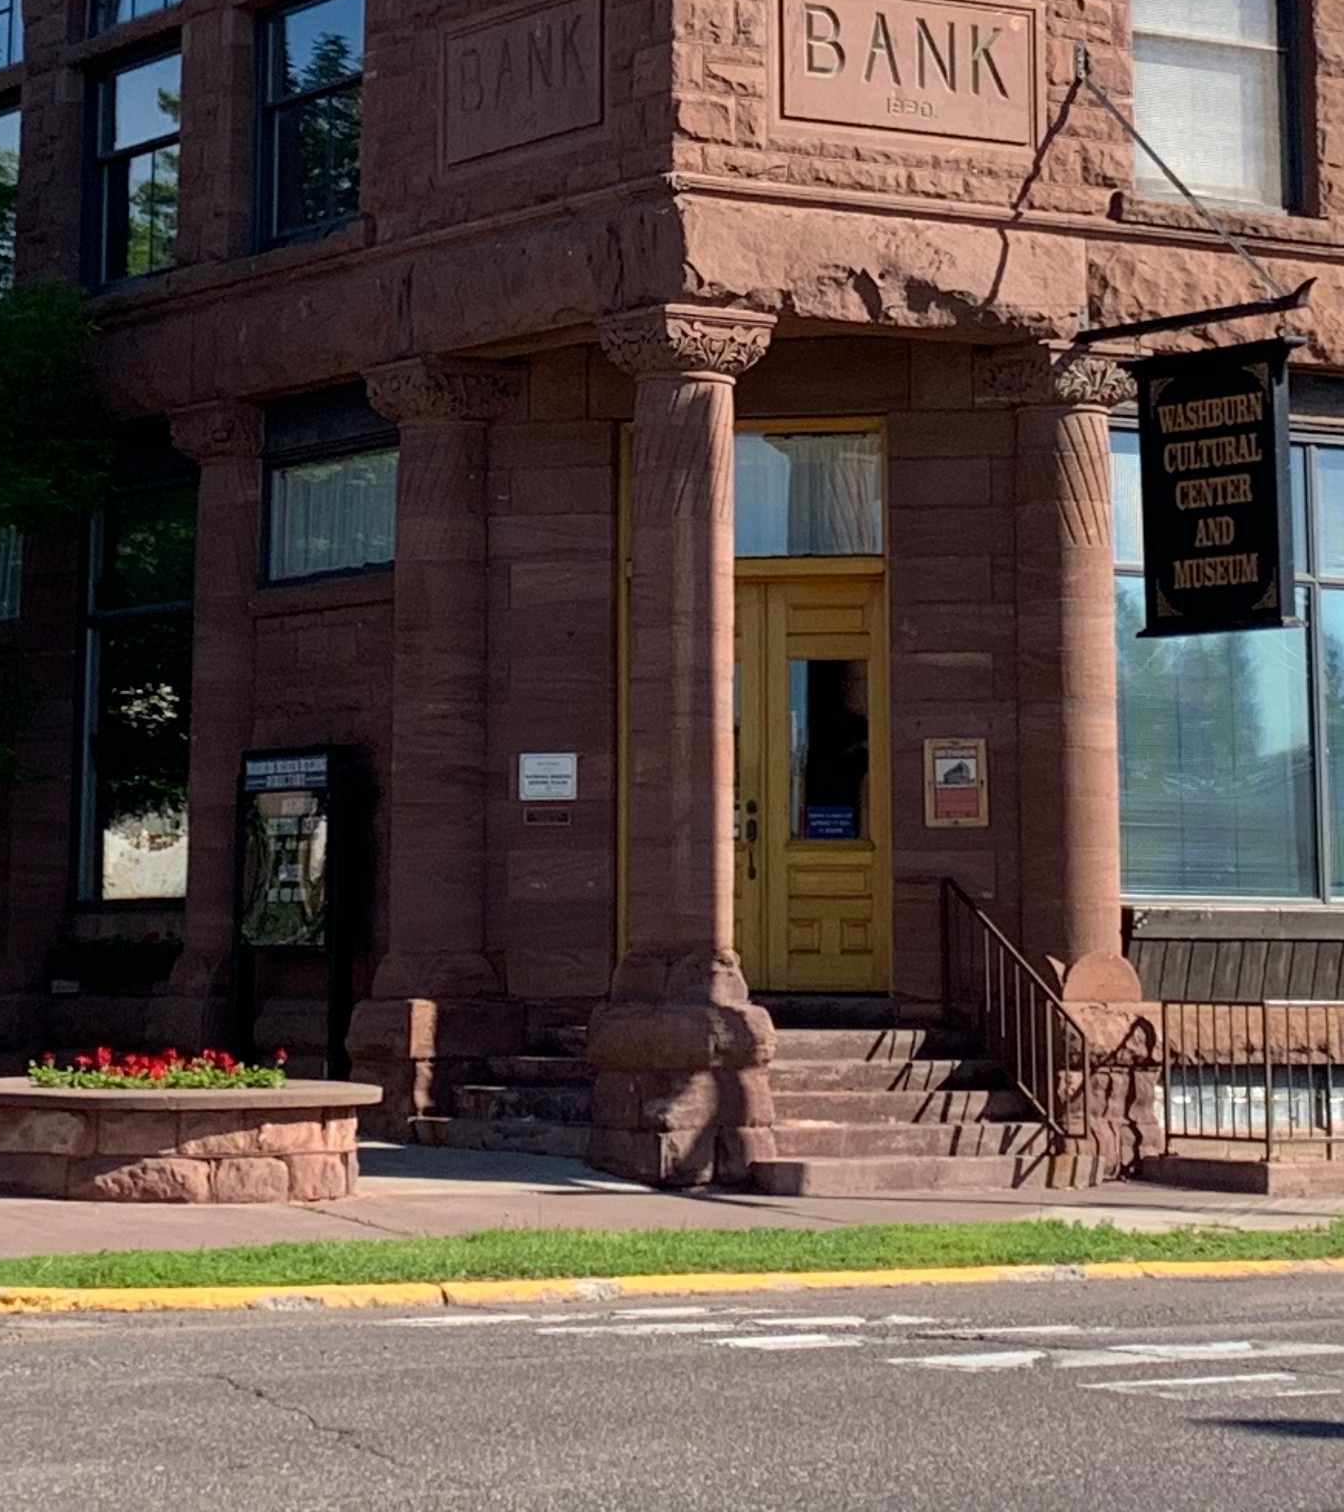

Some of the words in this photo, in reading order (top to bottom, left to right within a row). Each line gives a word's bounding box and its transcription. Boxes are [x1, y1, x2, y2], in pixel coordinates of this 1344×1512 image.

[460, 13, 587, 113] BANK
[804, 1, 1010, 99] BANK
[1158, 391, 1263, 434] WASHBURN
[1164, 432, 1262, 474] CULTURAL
[1175, 473, 1253, 511] CENTER
[1194, 515, 1235, 548] AND
[1173, 552, 1258, 589] MUSEUM
